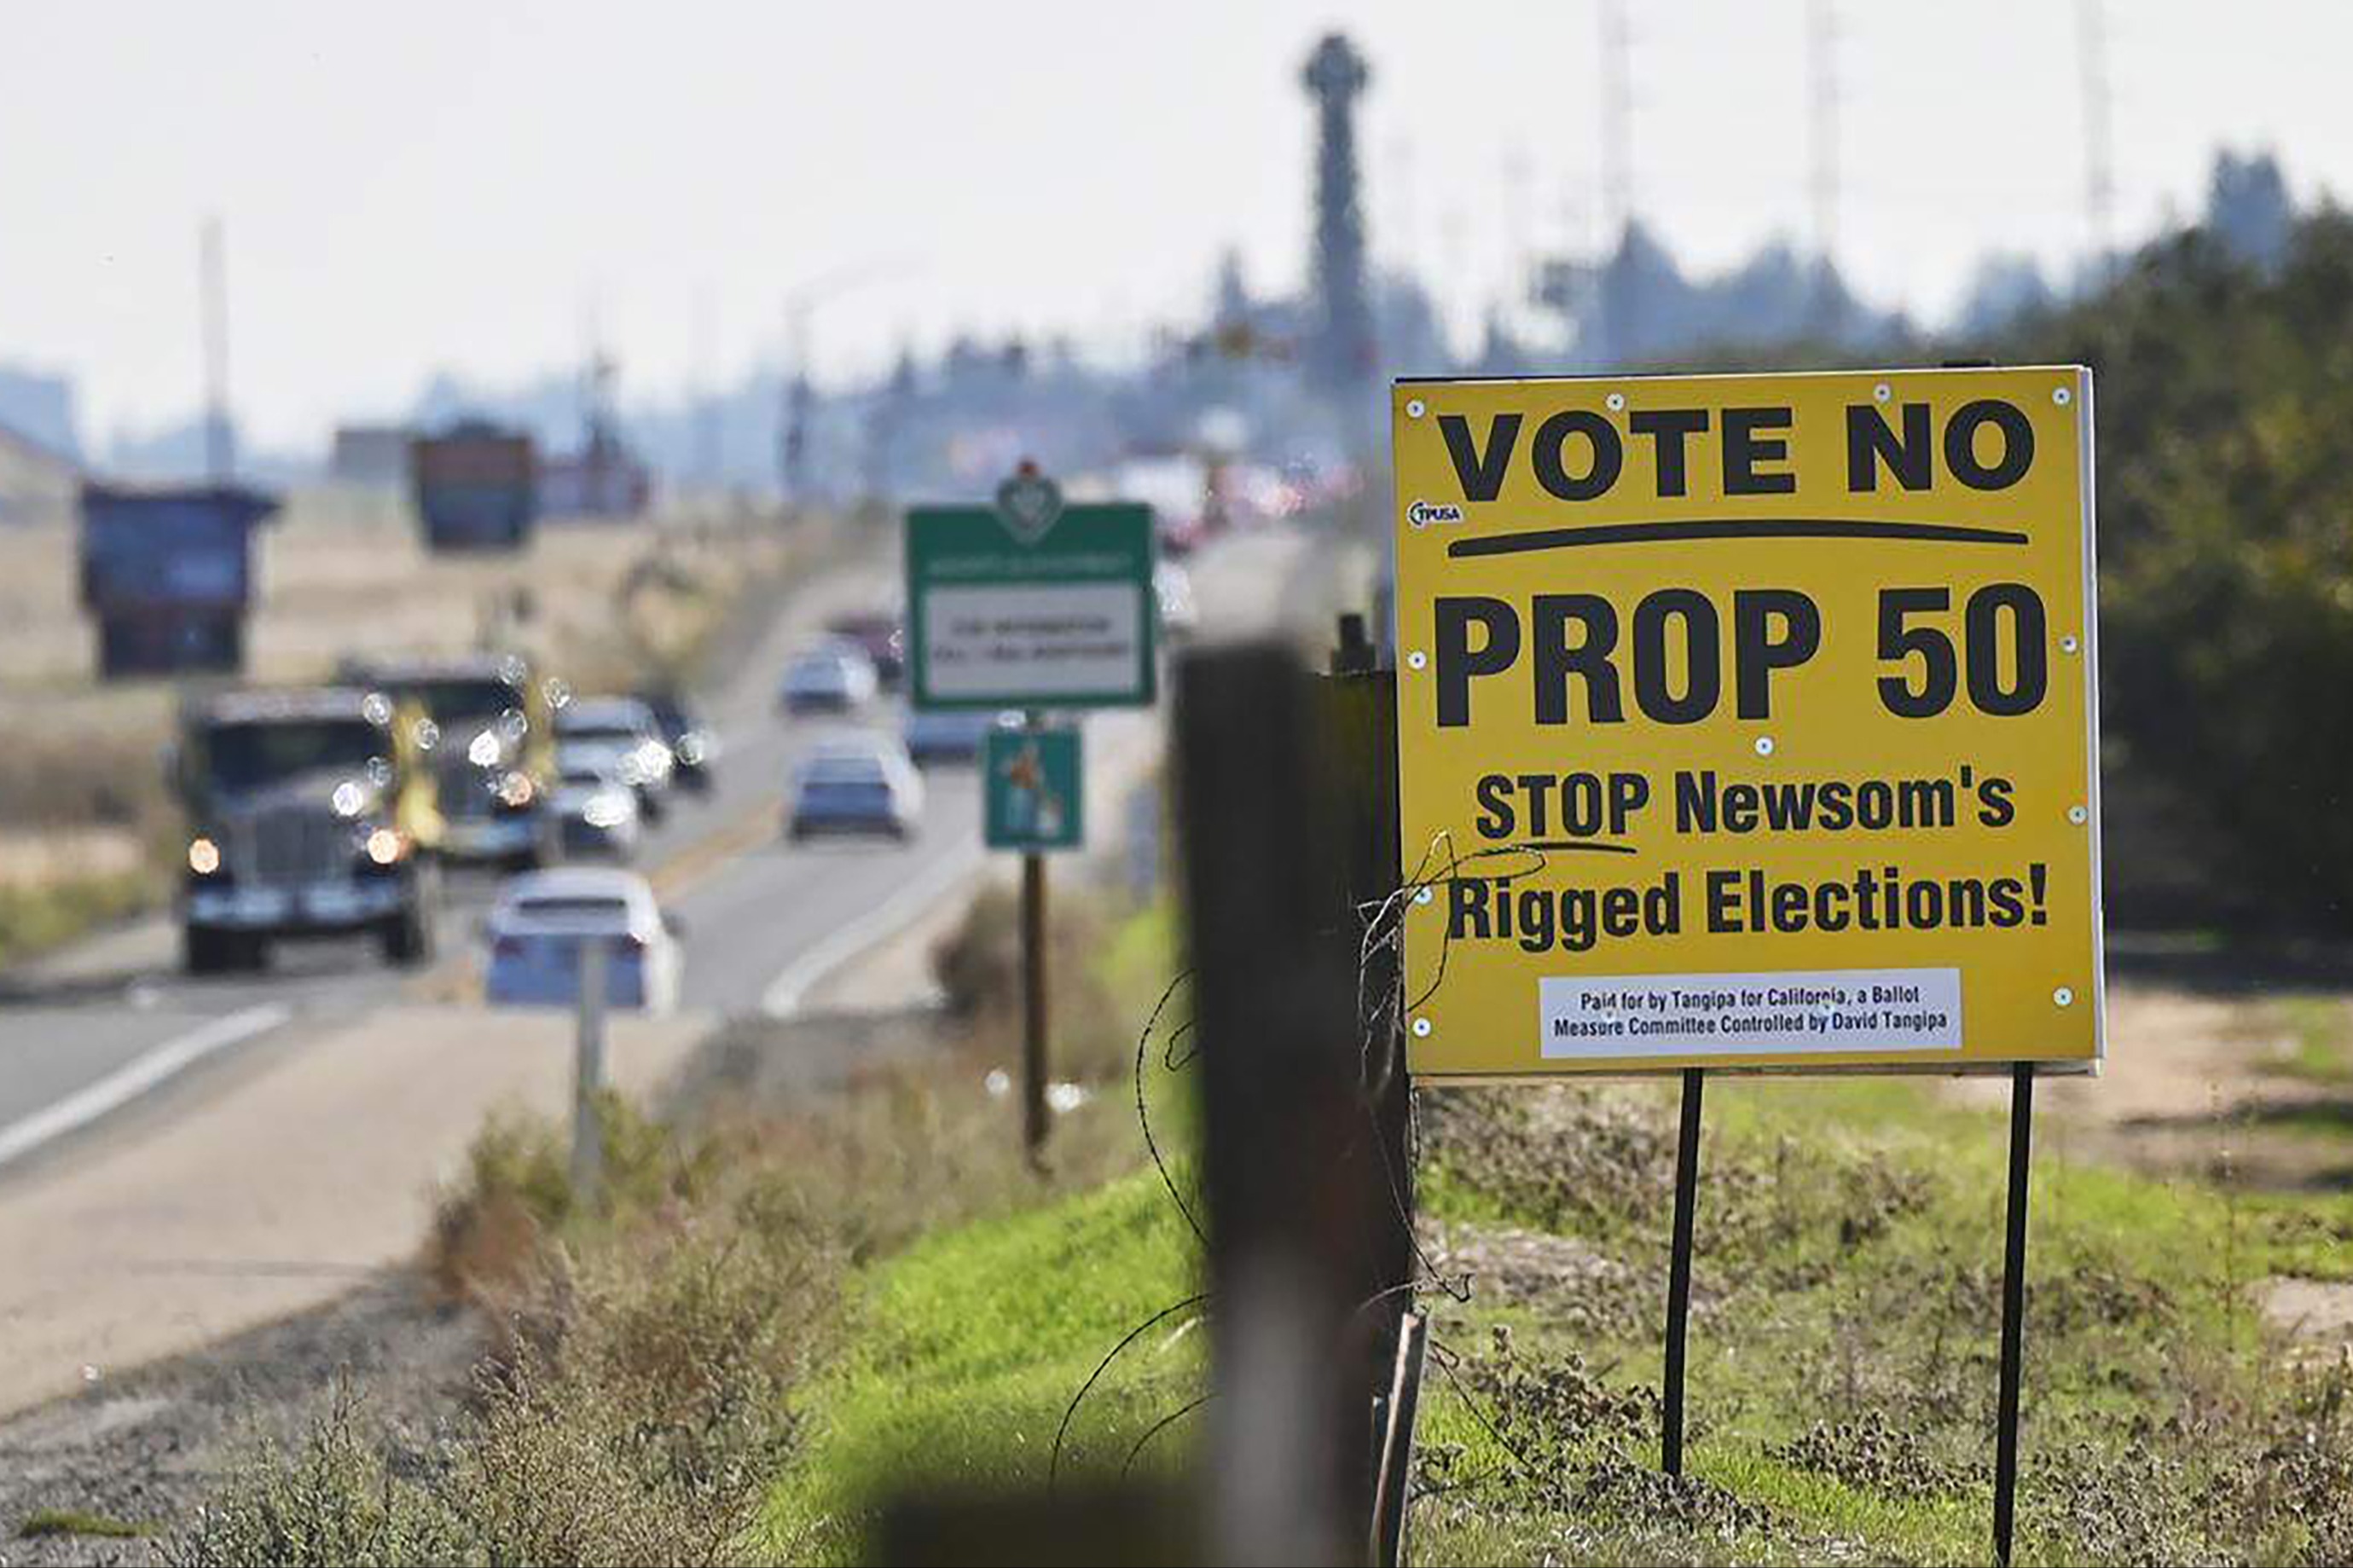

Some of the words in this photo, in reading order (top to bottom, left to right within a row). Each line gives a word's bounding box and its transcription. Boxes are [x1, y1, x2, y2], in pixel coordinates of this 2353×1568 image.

[1437, 407, 1796, 502] VOTE
[1846, 399, 2035, 492] NO
[1410, 501, 1460, 525] TPUSA
[1434, 587, 1822, 727] PROP
[1876, 582, 2047, 719] 50
[1476, 771, 1649, 839] STOP
[1675, 766, 2015, 834] Newsom's
[1450, 872, 1680, 953] Rigged
[1707, 864, 2048, 935] Elections!
[1554, 1020, 1624, 1037] Measure
[1628, 1016, 1717, 1034] Committee
[1720, 1014, 1805, 1033] Controlled
[1809, 1012, 1828, 1034] by
[1832, 1010, 1878, 1030] David
[1881, 1010, 1948, 1033] Tangipa
[1580, 992, 1617, 1010] Paid
[1622, 991, 1643, 1010] for
[1648, 990, 1667, 1013] by
[1672, 988, 1736, 1012] Tangipa
[1741, 988, 1763, 1007] for
[1857, 990, 1868, 1004] a
[1872, 986, 1920, 1004] Ballot
